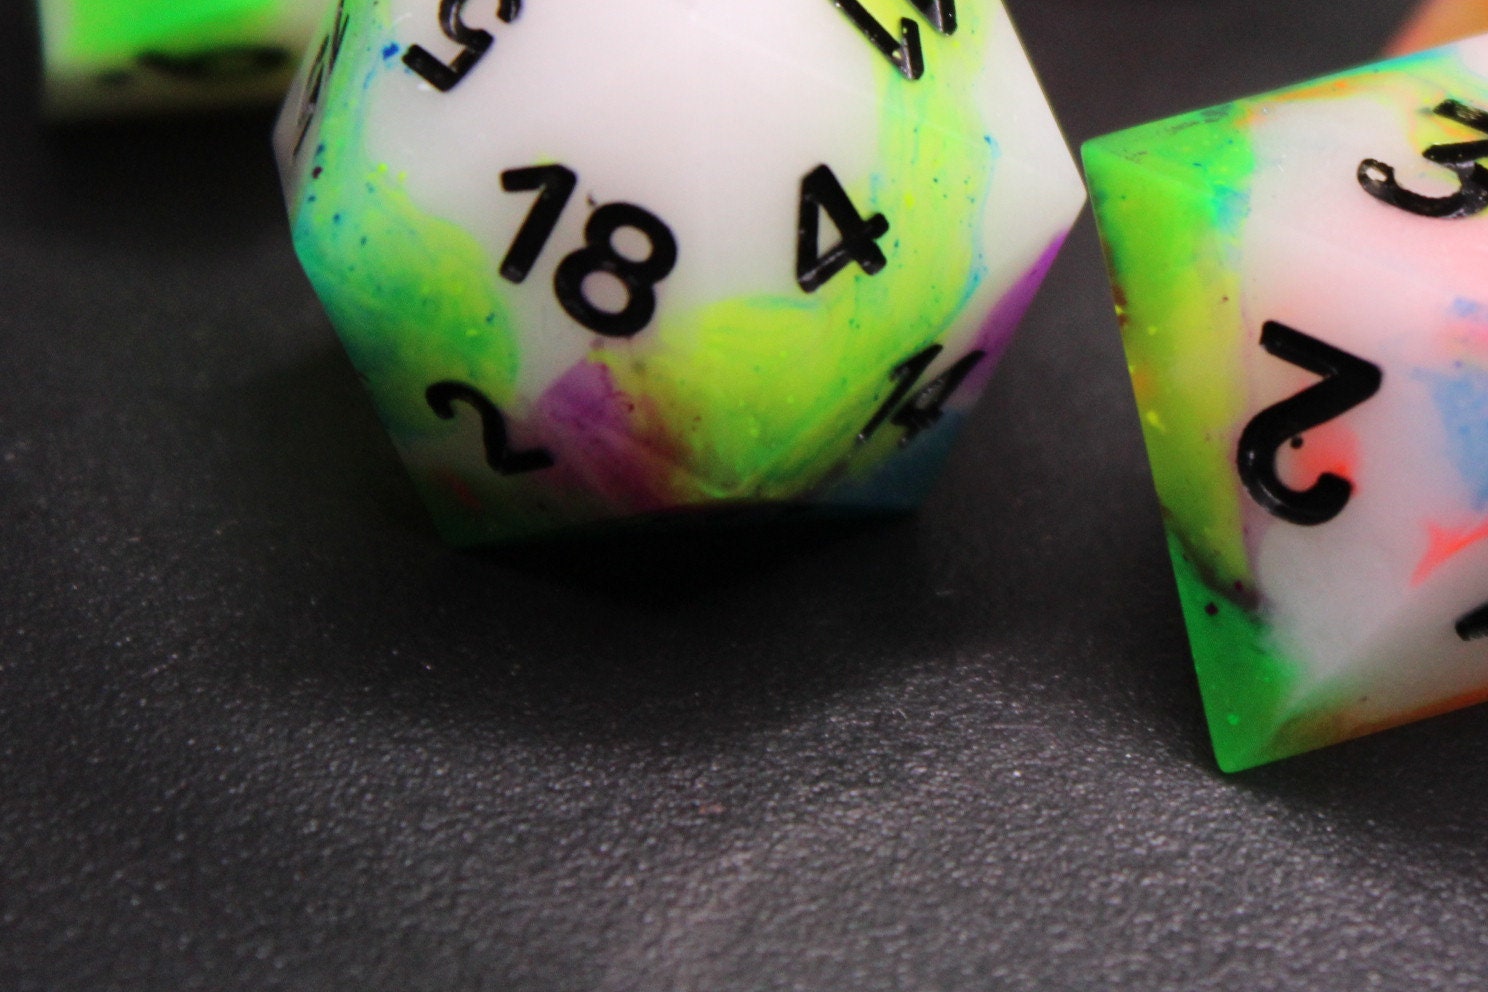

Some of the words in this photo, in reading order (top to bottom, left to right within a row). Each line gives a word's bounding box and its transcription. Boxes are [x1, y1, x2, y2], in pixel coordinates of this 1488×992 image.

[500, 164, 676, 337] 18
[796, 164, 889, 293] 4
[425, 380, 554, 476] 2
[1237, 320, 1382, 526] 2
